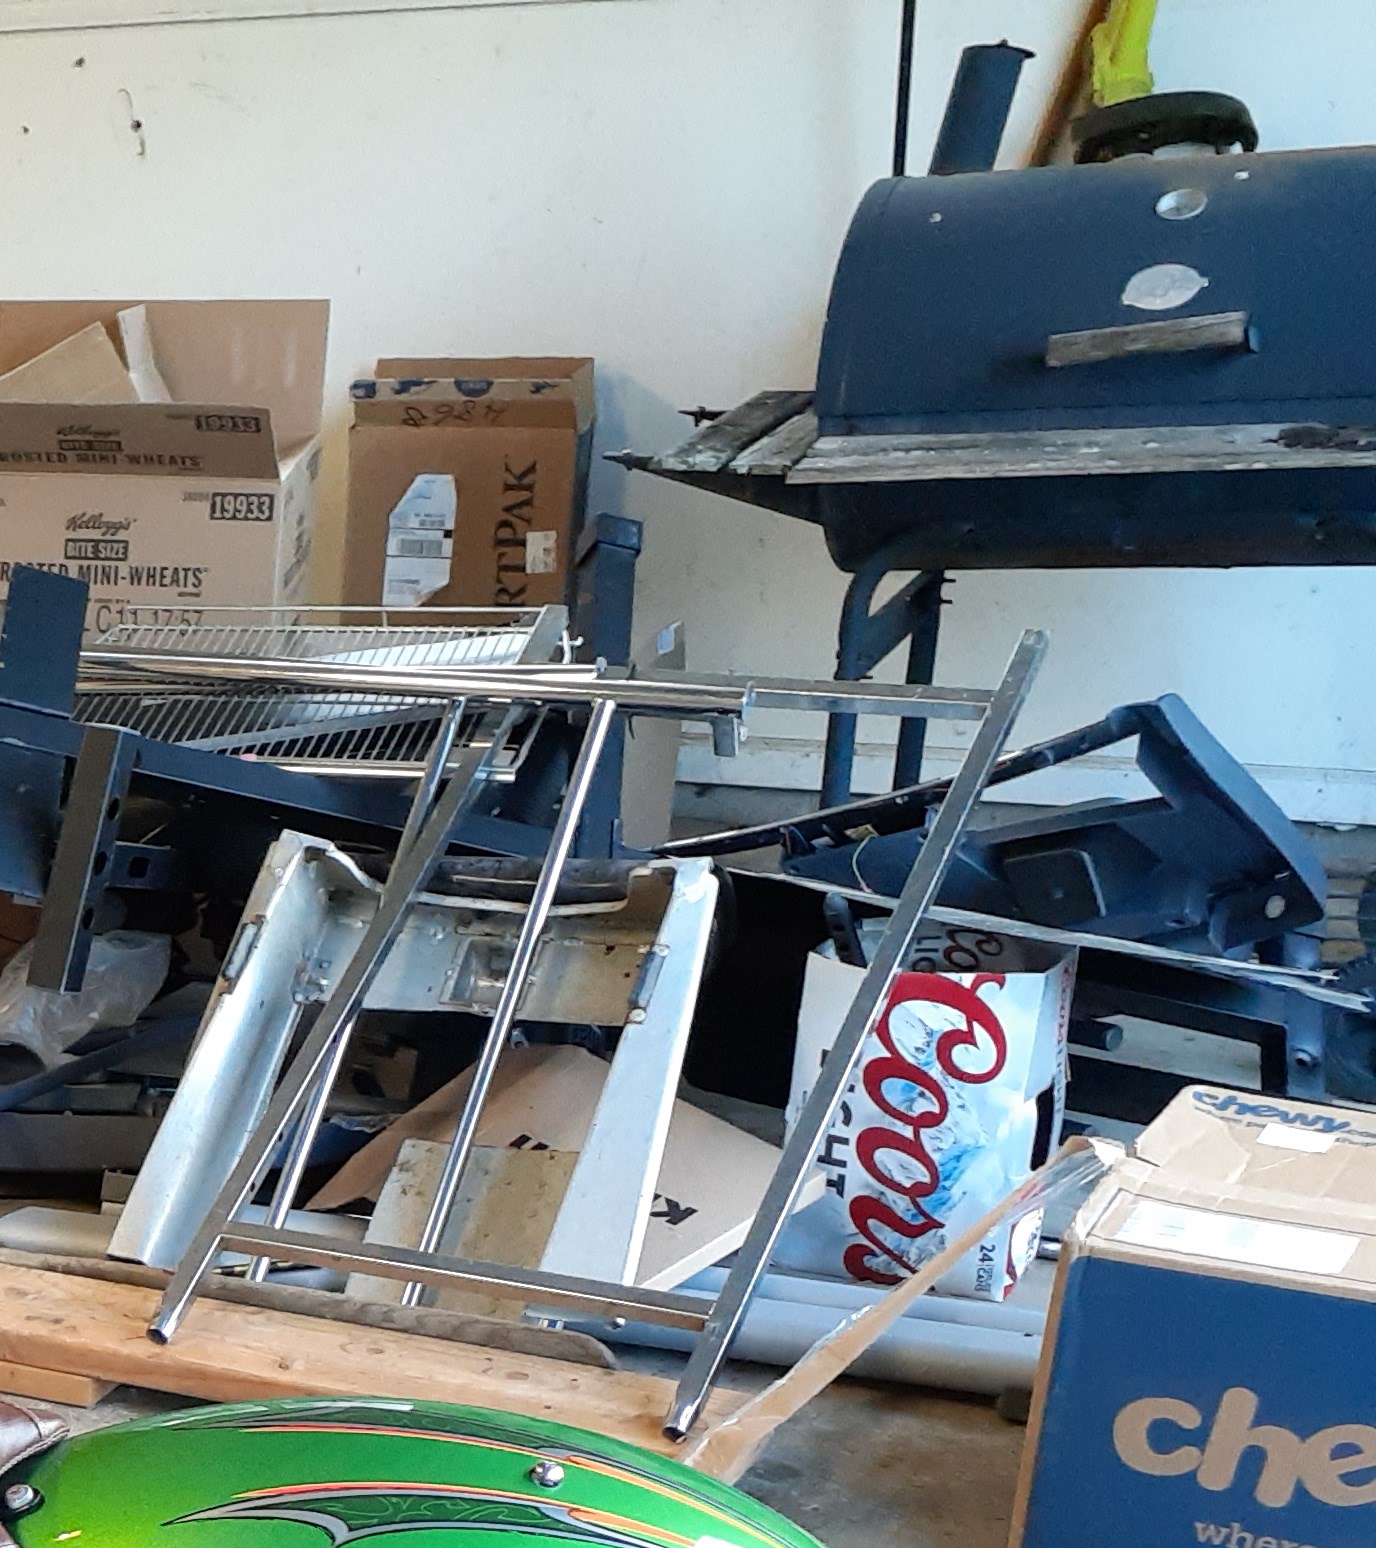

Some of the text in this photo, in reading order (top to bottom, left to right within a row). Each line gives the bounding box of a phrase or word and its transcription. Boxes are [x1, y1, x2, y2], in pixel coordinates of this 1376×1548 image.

[196, 415, 261, 433] 19933
[213, 494, 272, 520] 19933
[65, 512, 134, 536] Kellogg's
[66, 541, 128, 559] BITE SIZE
[843, 973, 1007, 1285] Coors
[977, 1243, 997, 1264] 24
[1113, 1386, 1376, 1508] che
